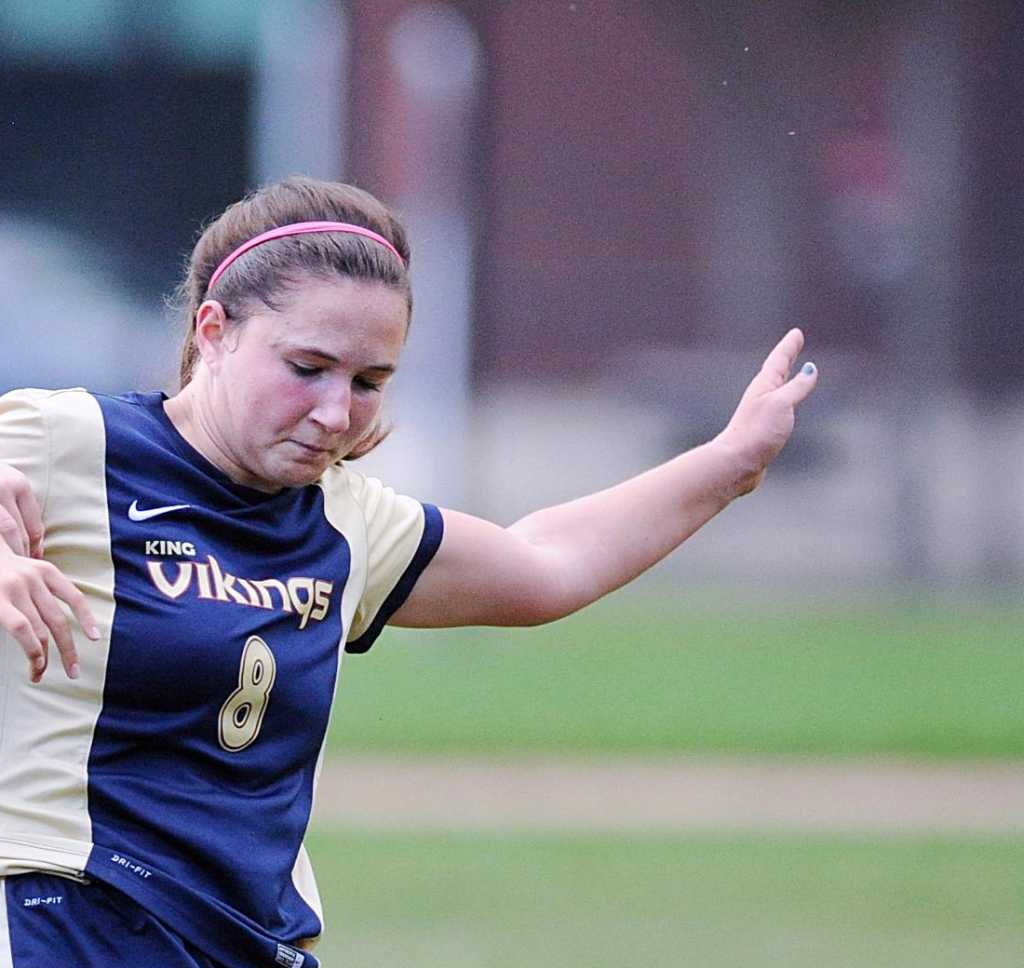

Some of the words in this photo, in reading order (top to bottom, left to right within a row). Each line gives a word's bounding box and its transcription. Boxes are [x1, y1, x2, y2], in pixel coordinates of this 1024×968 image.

[145, 540, 197, 556] KING
[147, 554, 334, 630] Vikings
[217, 634, 277, 753] 8
[111, 854, 152, 879] DRI-FIT
[23, 896, 63, 907] DRI-FIT
